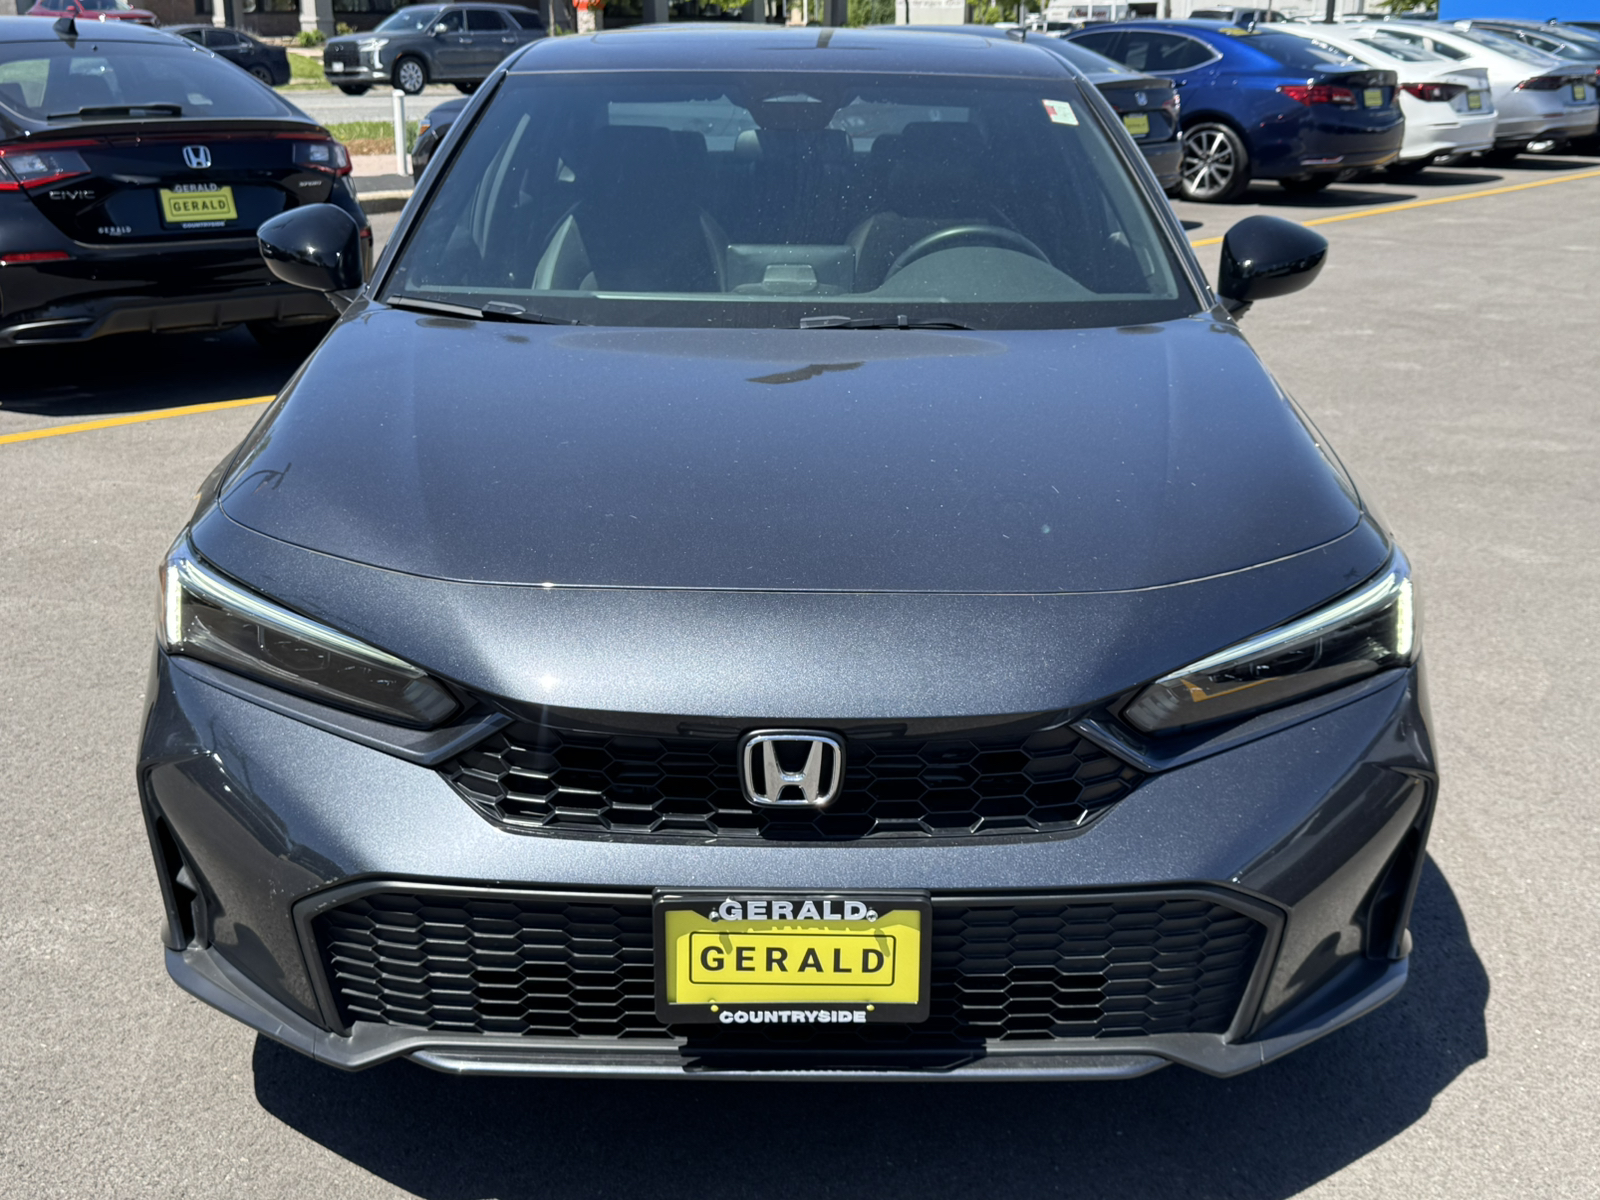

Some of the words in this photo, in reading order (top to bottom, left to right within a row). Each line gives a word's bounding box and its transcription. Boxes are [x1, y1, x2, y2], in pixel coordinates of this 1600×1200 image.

[49, 190, 95, 199] CIVIC
[174, 183, 218, 193] GERALD
[173, 200, 226, 212] GERALD
[718, 900, 867, 921] GERALD
[700, 946, 884, 974] GERALD
[719, 1010, 866, 1024] COUNTRYSIDE
